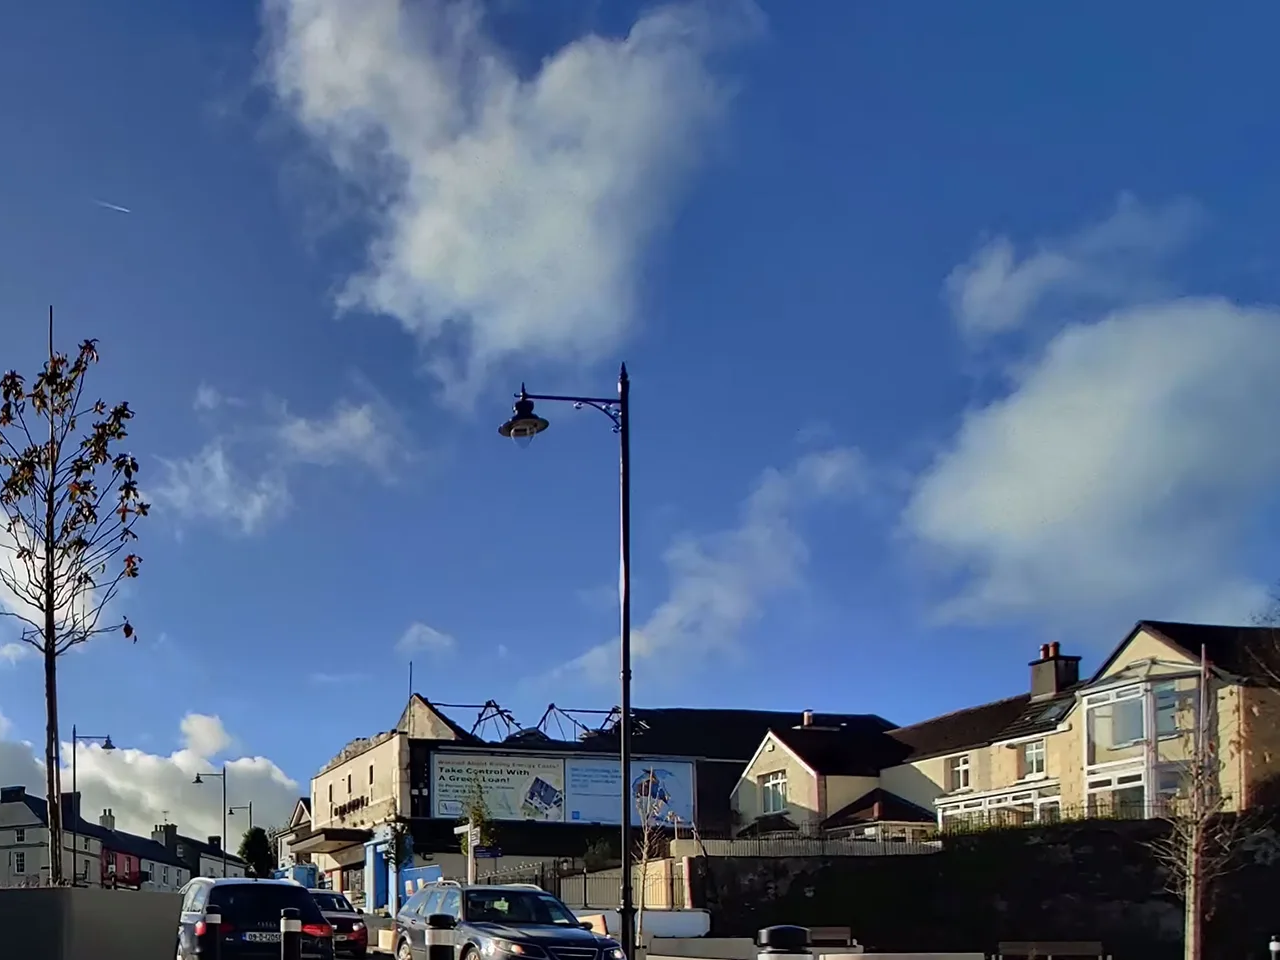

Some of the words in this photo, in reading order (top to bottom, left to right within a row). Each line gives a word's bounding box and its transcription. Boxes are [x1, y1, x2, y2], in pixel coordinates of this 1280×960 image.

[438, 766, 464, 774] Take
[466, 767, 503, 775] Control
[506, 768, 530, 776] With
[448, 775, 480, 783] Green
